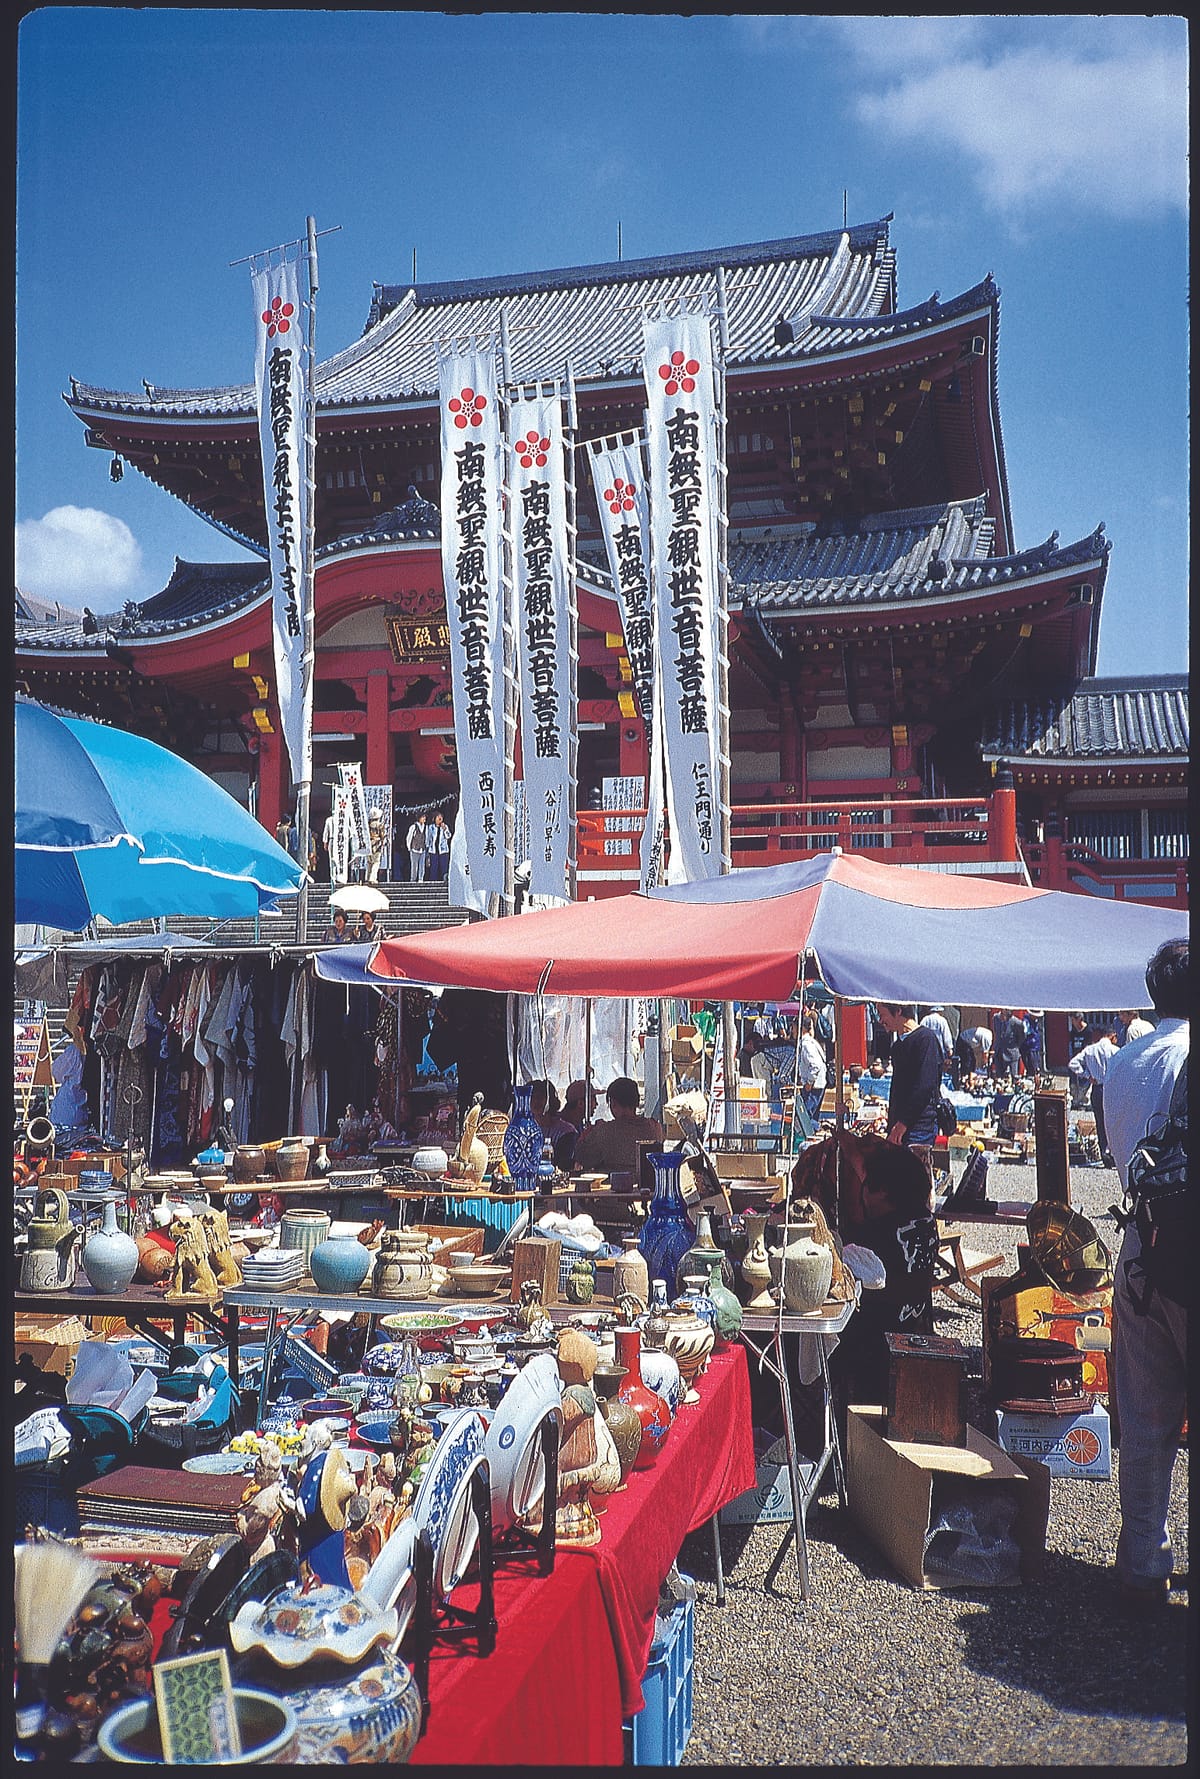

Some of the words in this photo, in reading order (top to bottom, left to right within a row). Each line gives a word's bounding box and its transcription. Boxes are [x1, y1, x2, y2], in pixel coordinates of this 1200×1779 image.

[453, 441, 493, 740] 南無聖観世音菩薩
[519, 480, 562, 759] 南無聖観世音菩薩
[664, 407, 709, 735] 南無聖観世音菩薩
[477, 771, 497, 858] 西川長寿
[691, 762, 715, 855] 仁王門通り
[1019, 1438, 1077, 1452] 河内みかん
